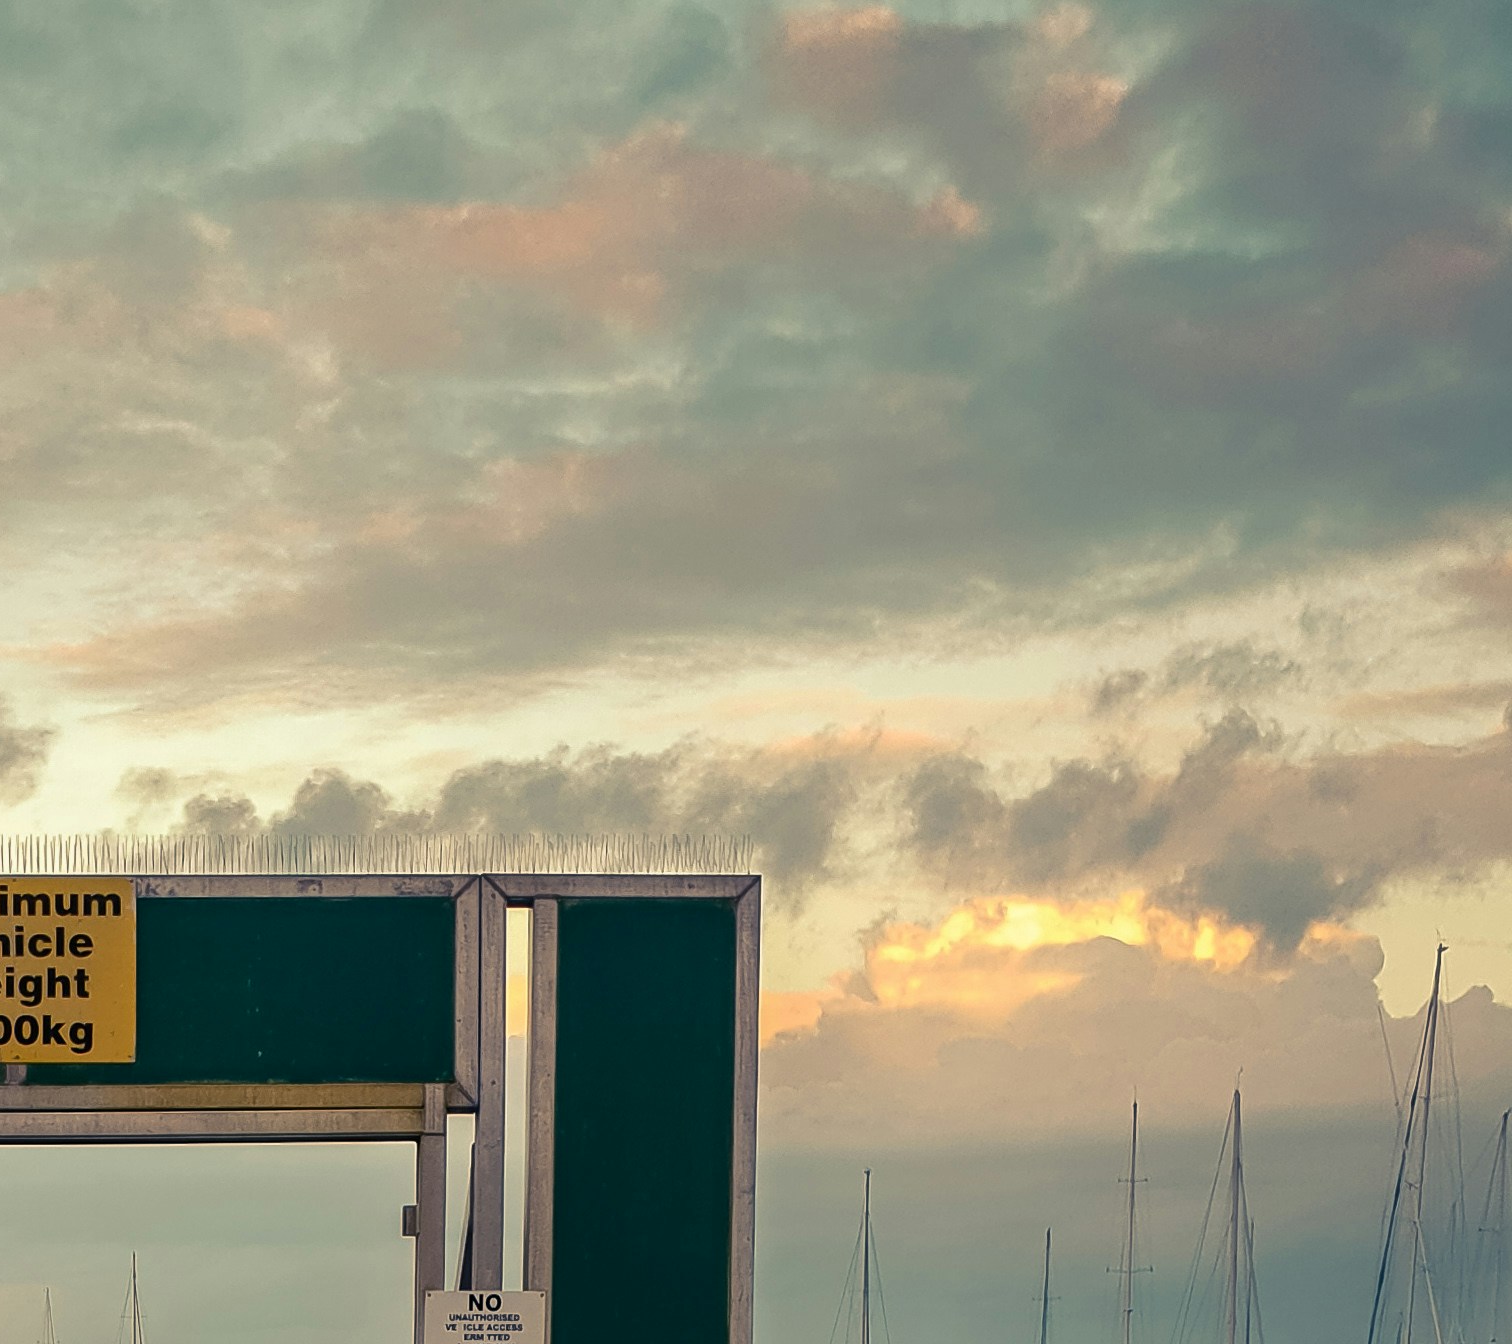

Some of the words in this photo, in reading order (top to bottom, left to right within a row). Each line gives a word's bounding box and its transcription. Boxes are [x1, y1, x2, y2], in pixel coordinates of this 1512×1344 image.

[468, 1293, 502, 1312] NO
[445, 1323, 484, 1331] VEICLE
[486, 1323, 523, 1331] ACCESS
